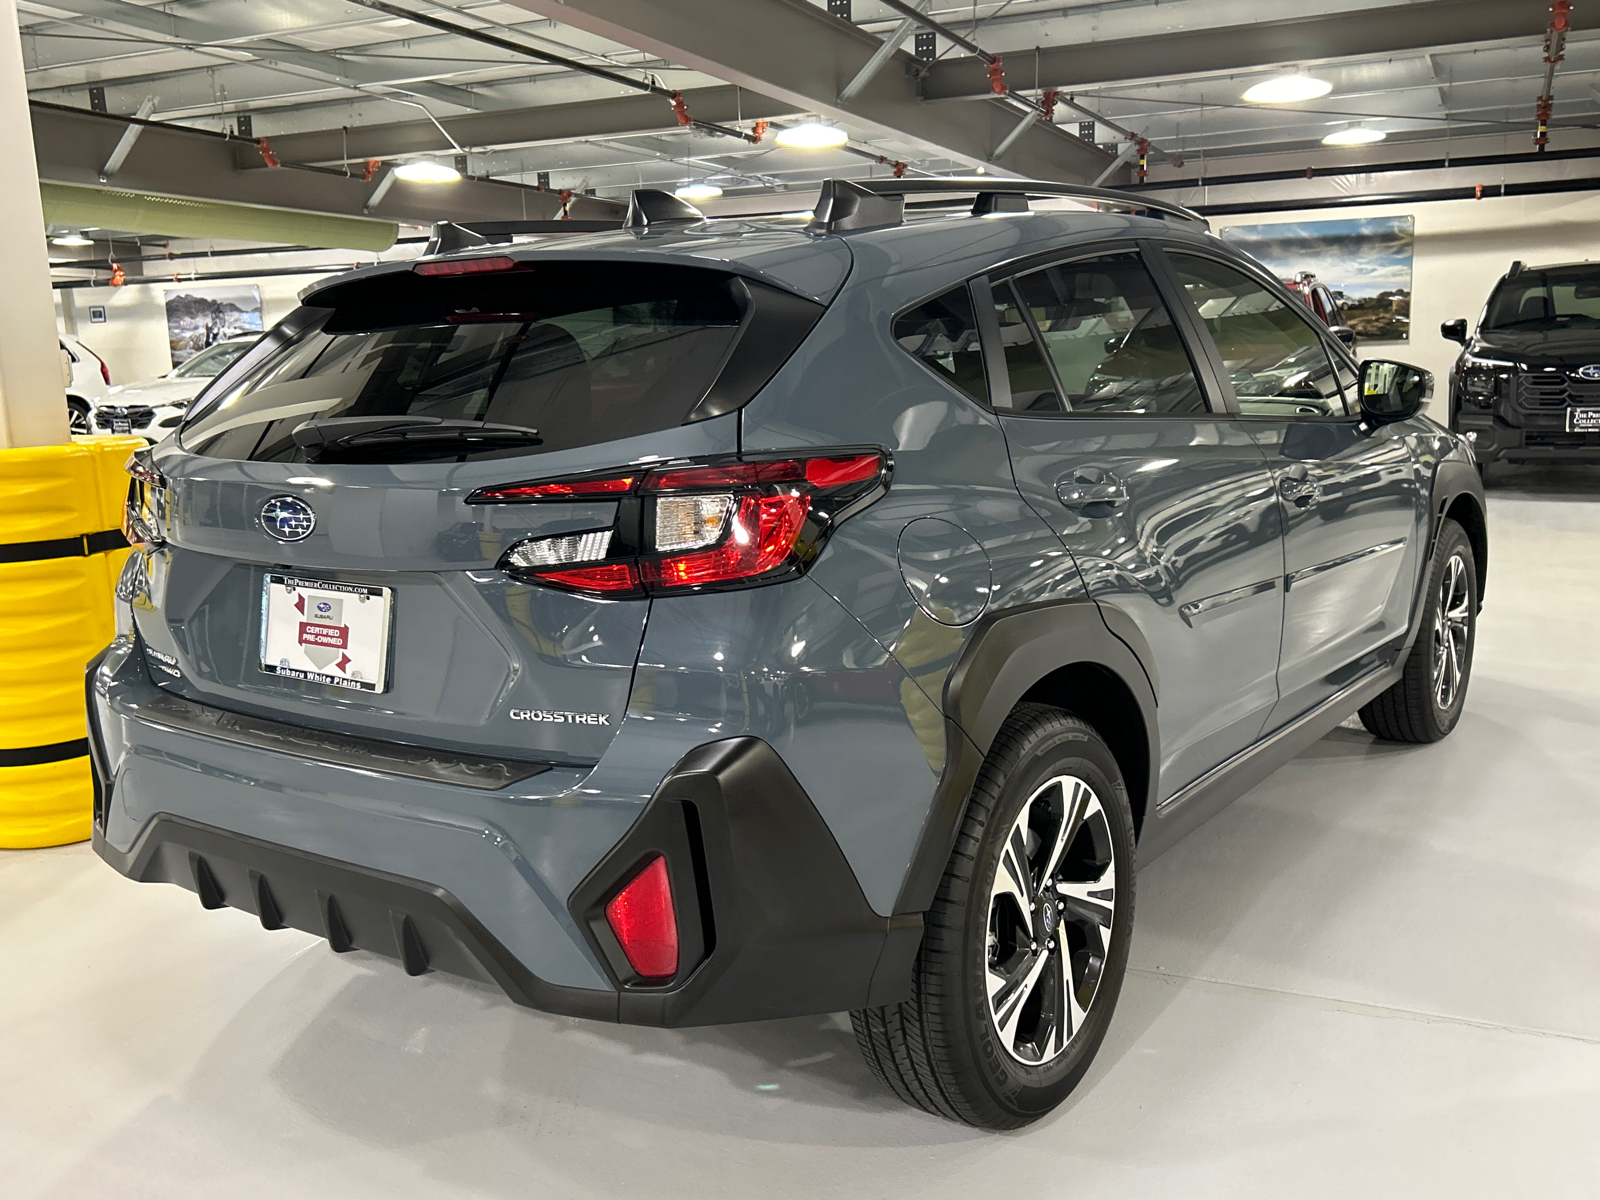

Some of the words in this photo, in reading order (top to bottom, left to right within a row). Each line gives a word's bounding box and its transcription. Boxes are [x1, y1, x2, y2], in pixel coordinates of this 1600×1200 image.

[306, 625, 340, 636] CERTIFIED
[302, 633, 343, 646] PRE-OWNED
[275, 666, 304, 679] Subaru
[306, 671, 332, 683] White
[334, 677, 361, 689] Plains
[509, 708, 610, 726] CROSSTREK
